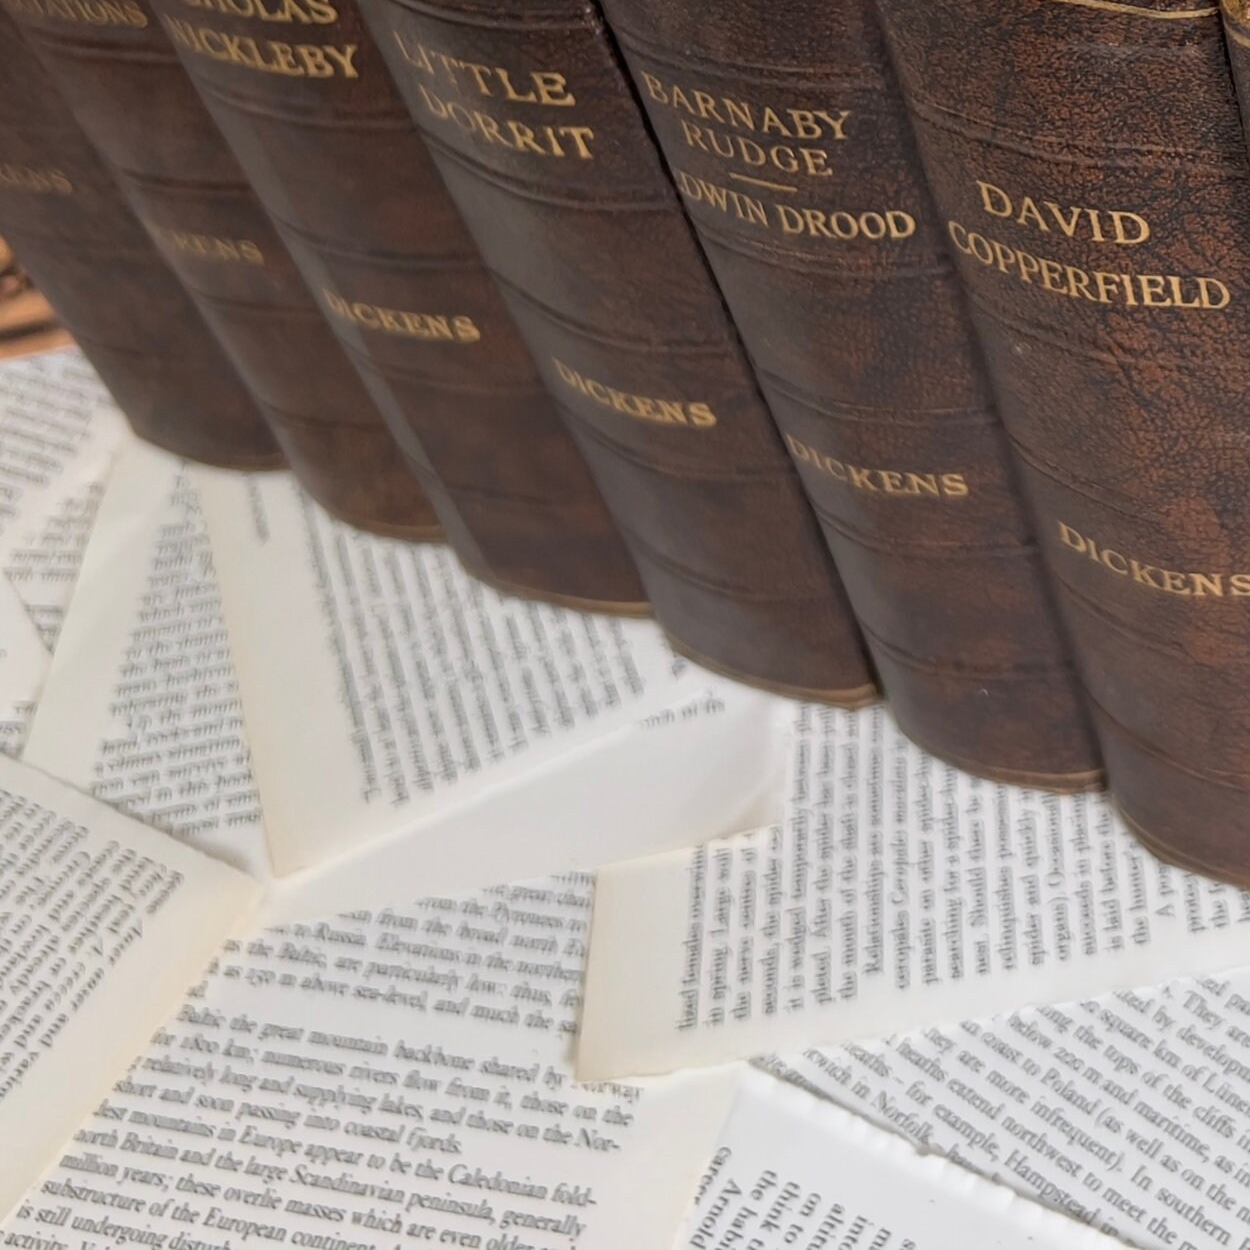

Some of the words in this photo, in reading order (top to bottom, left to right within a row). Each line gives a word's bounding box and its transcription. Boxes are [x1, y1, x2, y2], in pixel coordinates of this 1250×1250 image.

[163, 13, 359, 79] NICKLEBY
[393, 30, 577, 108] LITTLE
[419, 84, 595, 160] DORRIT
[641, 70, 851, 140] BARNABY
[680, 119, 833, 177] RUDGE
[674, 167, 769, 228] DWIN
[775, 203, 917, 240] DROOD
[976, 179, 1151, 246] DAVID
[948, 219, 1232, 310] COPPERFIELD
[552, 354, 718, 429] DICKENS
[784, 431, 970, 497] DICKENS
[1153, 1006, 1175, 1031] by
[1183, 991, 1222, 1028] They
[1100, 1011, 1152, 1049] square
[1153, 1040, 1181, 1068] km
[1182, 1065, 1207, 1081] of
[1074, 1026, 1102, 1050] the
[1104, 1045, 1138, 1075] tops
[1142, 1072, 1168, 1088] of
[1163, 1085, 1191, 1109] the
[1193, 1106, 1235, 1138] cliffs
[238, 1125, 305, 1157] Europe
[304, 1144, 364, 1166] appear
[367, 1154, 386, 1169] to
[390, 1153, 415, 1175] be
[414, 1159, 444, 1181] the
[448, 1164, 547, 1200] Caledonian
[551, 1183, 596, 1207] fold-
[1002, 1117, 1082, 1177] northwest
[41, 1178, 146, 1213] substructure
[149, 1199, 178, 1220] of
[171, 1199, 200, 1224] the
[202, 1207, 287, 1242] European
[243, 1156, 291, 1184] large
[289, 1164, 407, 1207] Scandinavian
[405, 1192, 496, 1225] peninsula,
[499, 1211, 586, 1242] generally
[689, 1179, 742, 1250] Arnold
[751, 1170, 777, 1201] the
[760, 1182, 800, 1232] think
[799, 1193, 821, 1217] on
[1004, 1149, 1101, 1227] Hampstead
[1157, 1188, 1231, 1246] southern
[35, 1206, 75, 1228] still
[71, 1216, 172, 1250] undergoing
[784, 1224, 804, 1244] to
